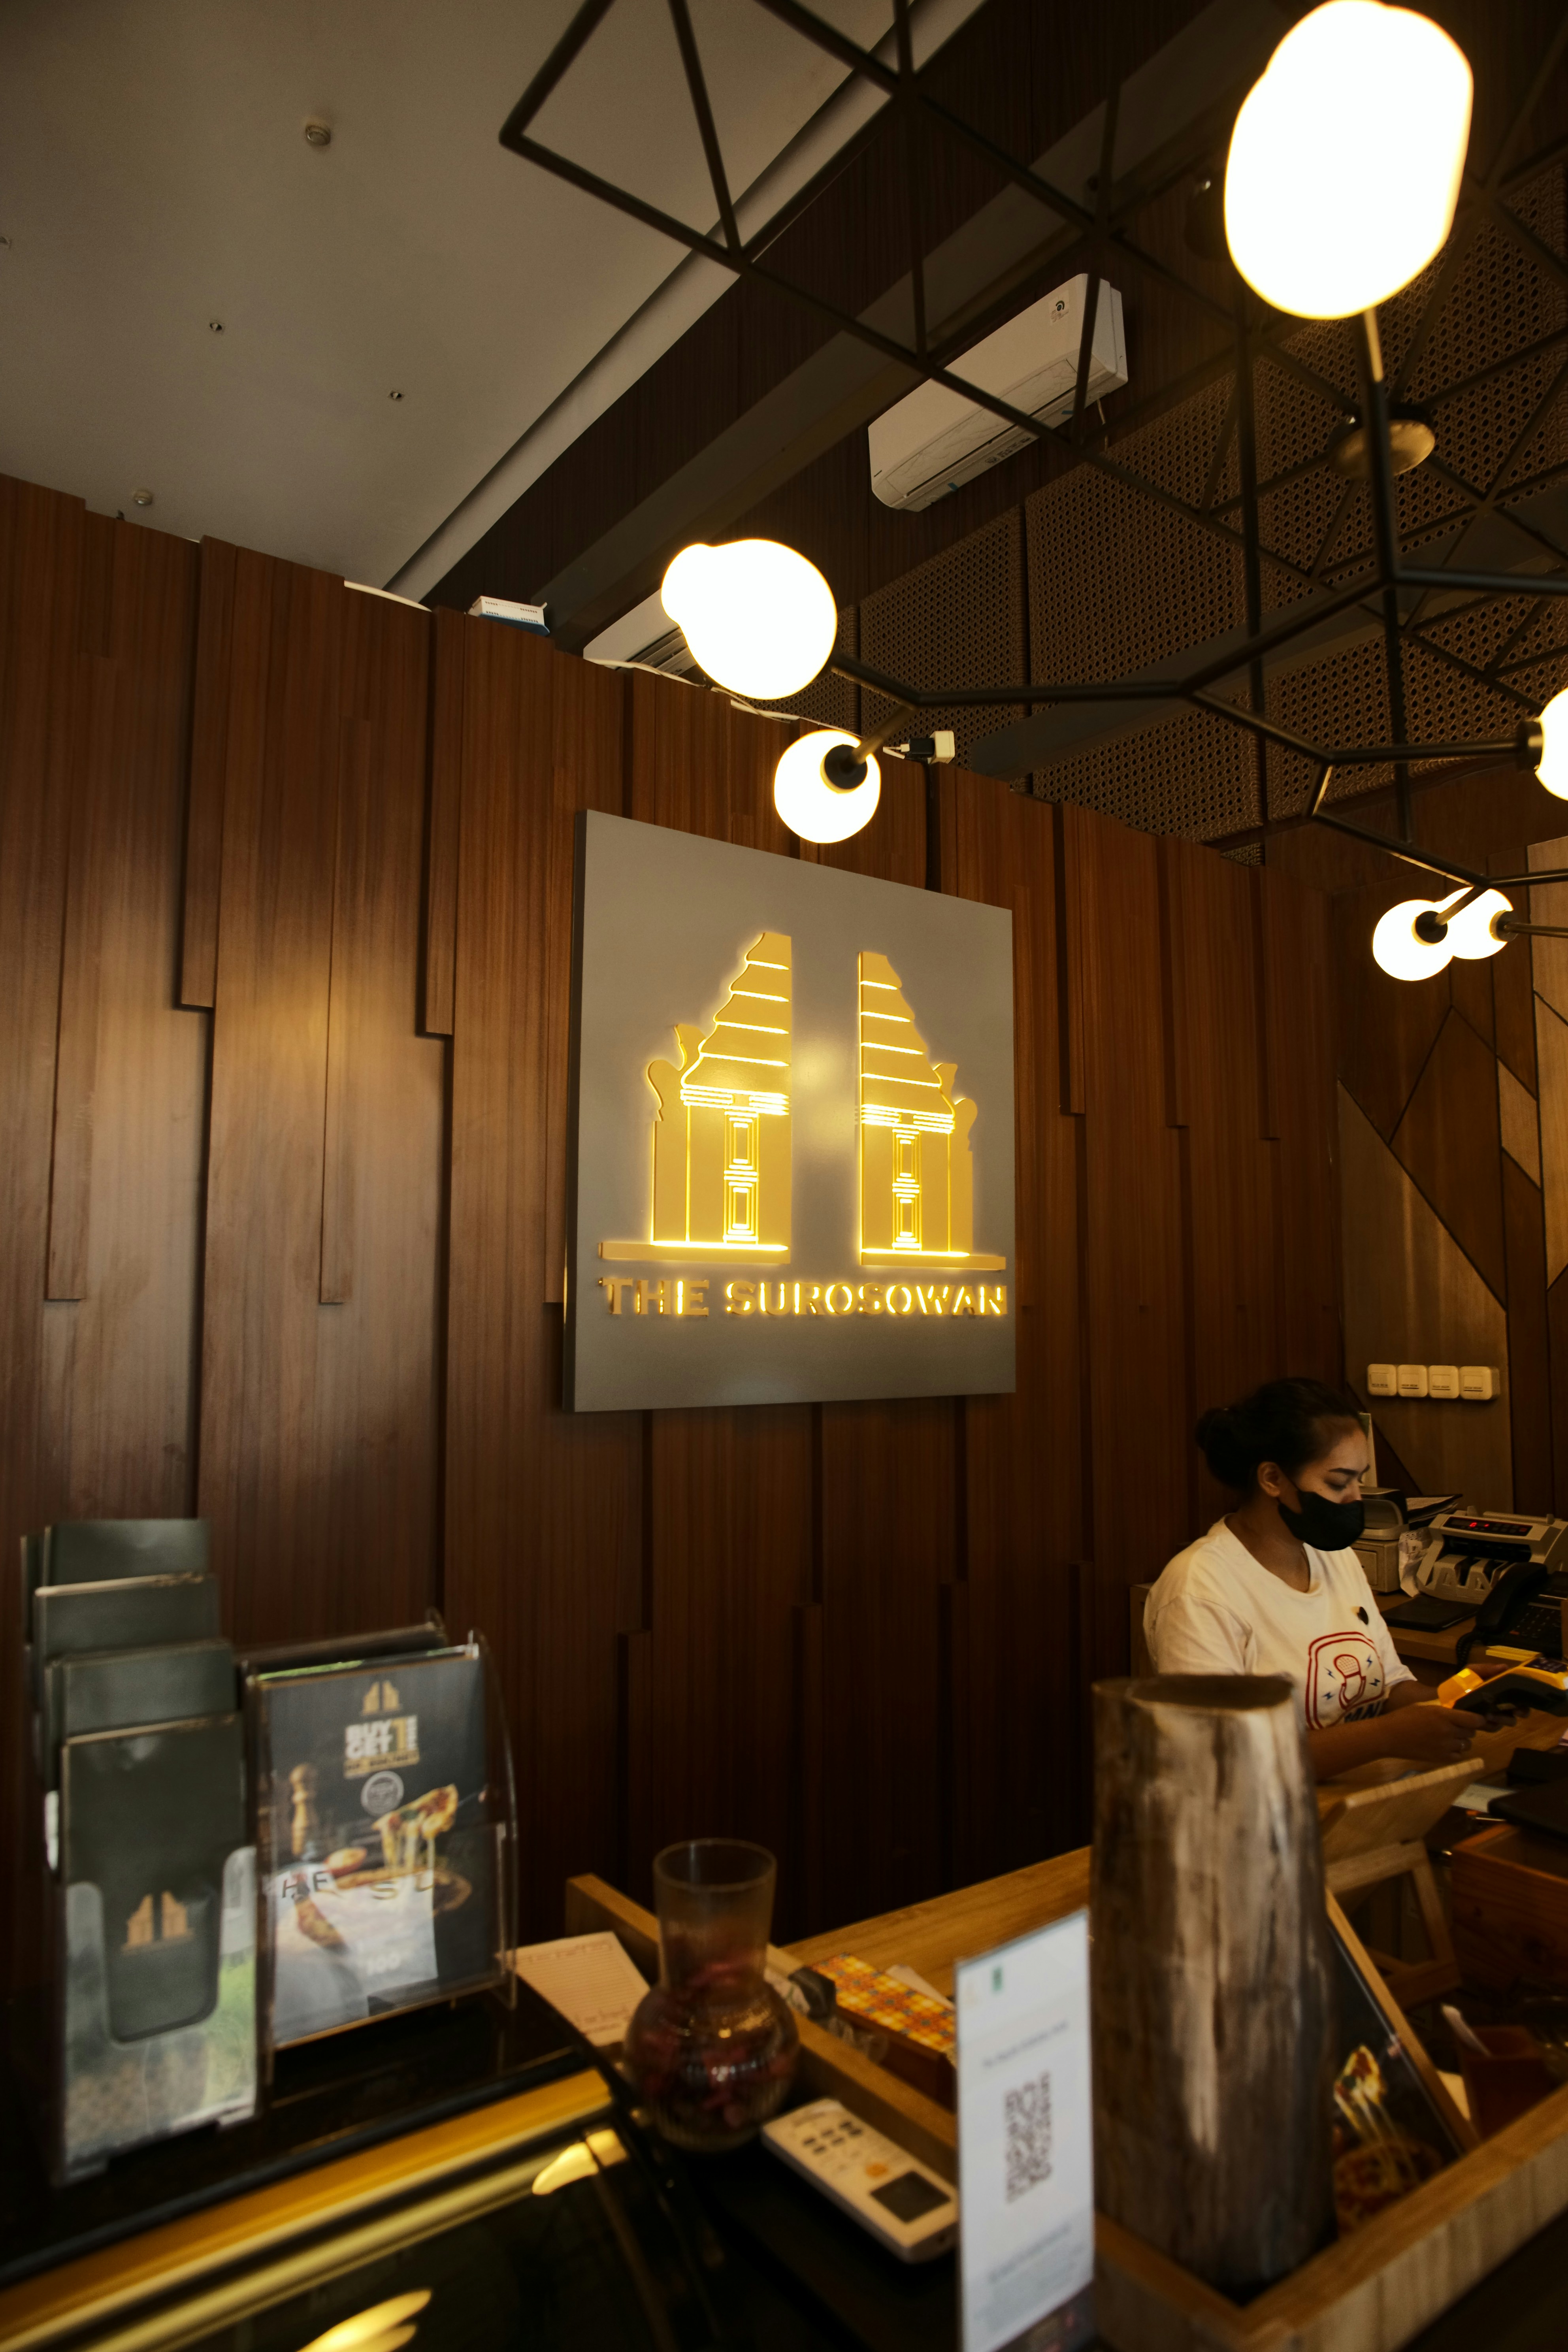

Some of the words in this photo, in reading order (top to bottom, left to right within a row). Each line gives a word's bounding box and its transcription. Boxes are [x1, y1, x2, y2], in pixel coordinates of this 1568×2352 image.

[598, 1277, 710, 1316] THE
[726, 1281, 1007, 1316] SUROSOWAN
[346, 1719, 393, 1741] BUY
